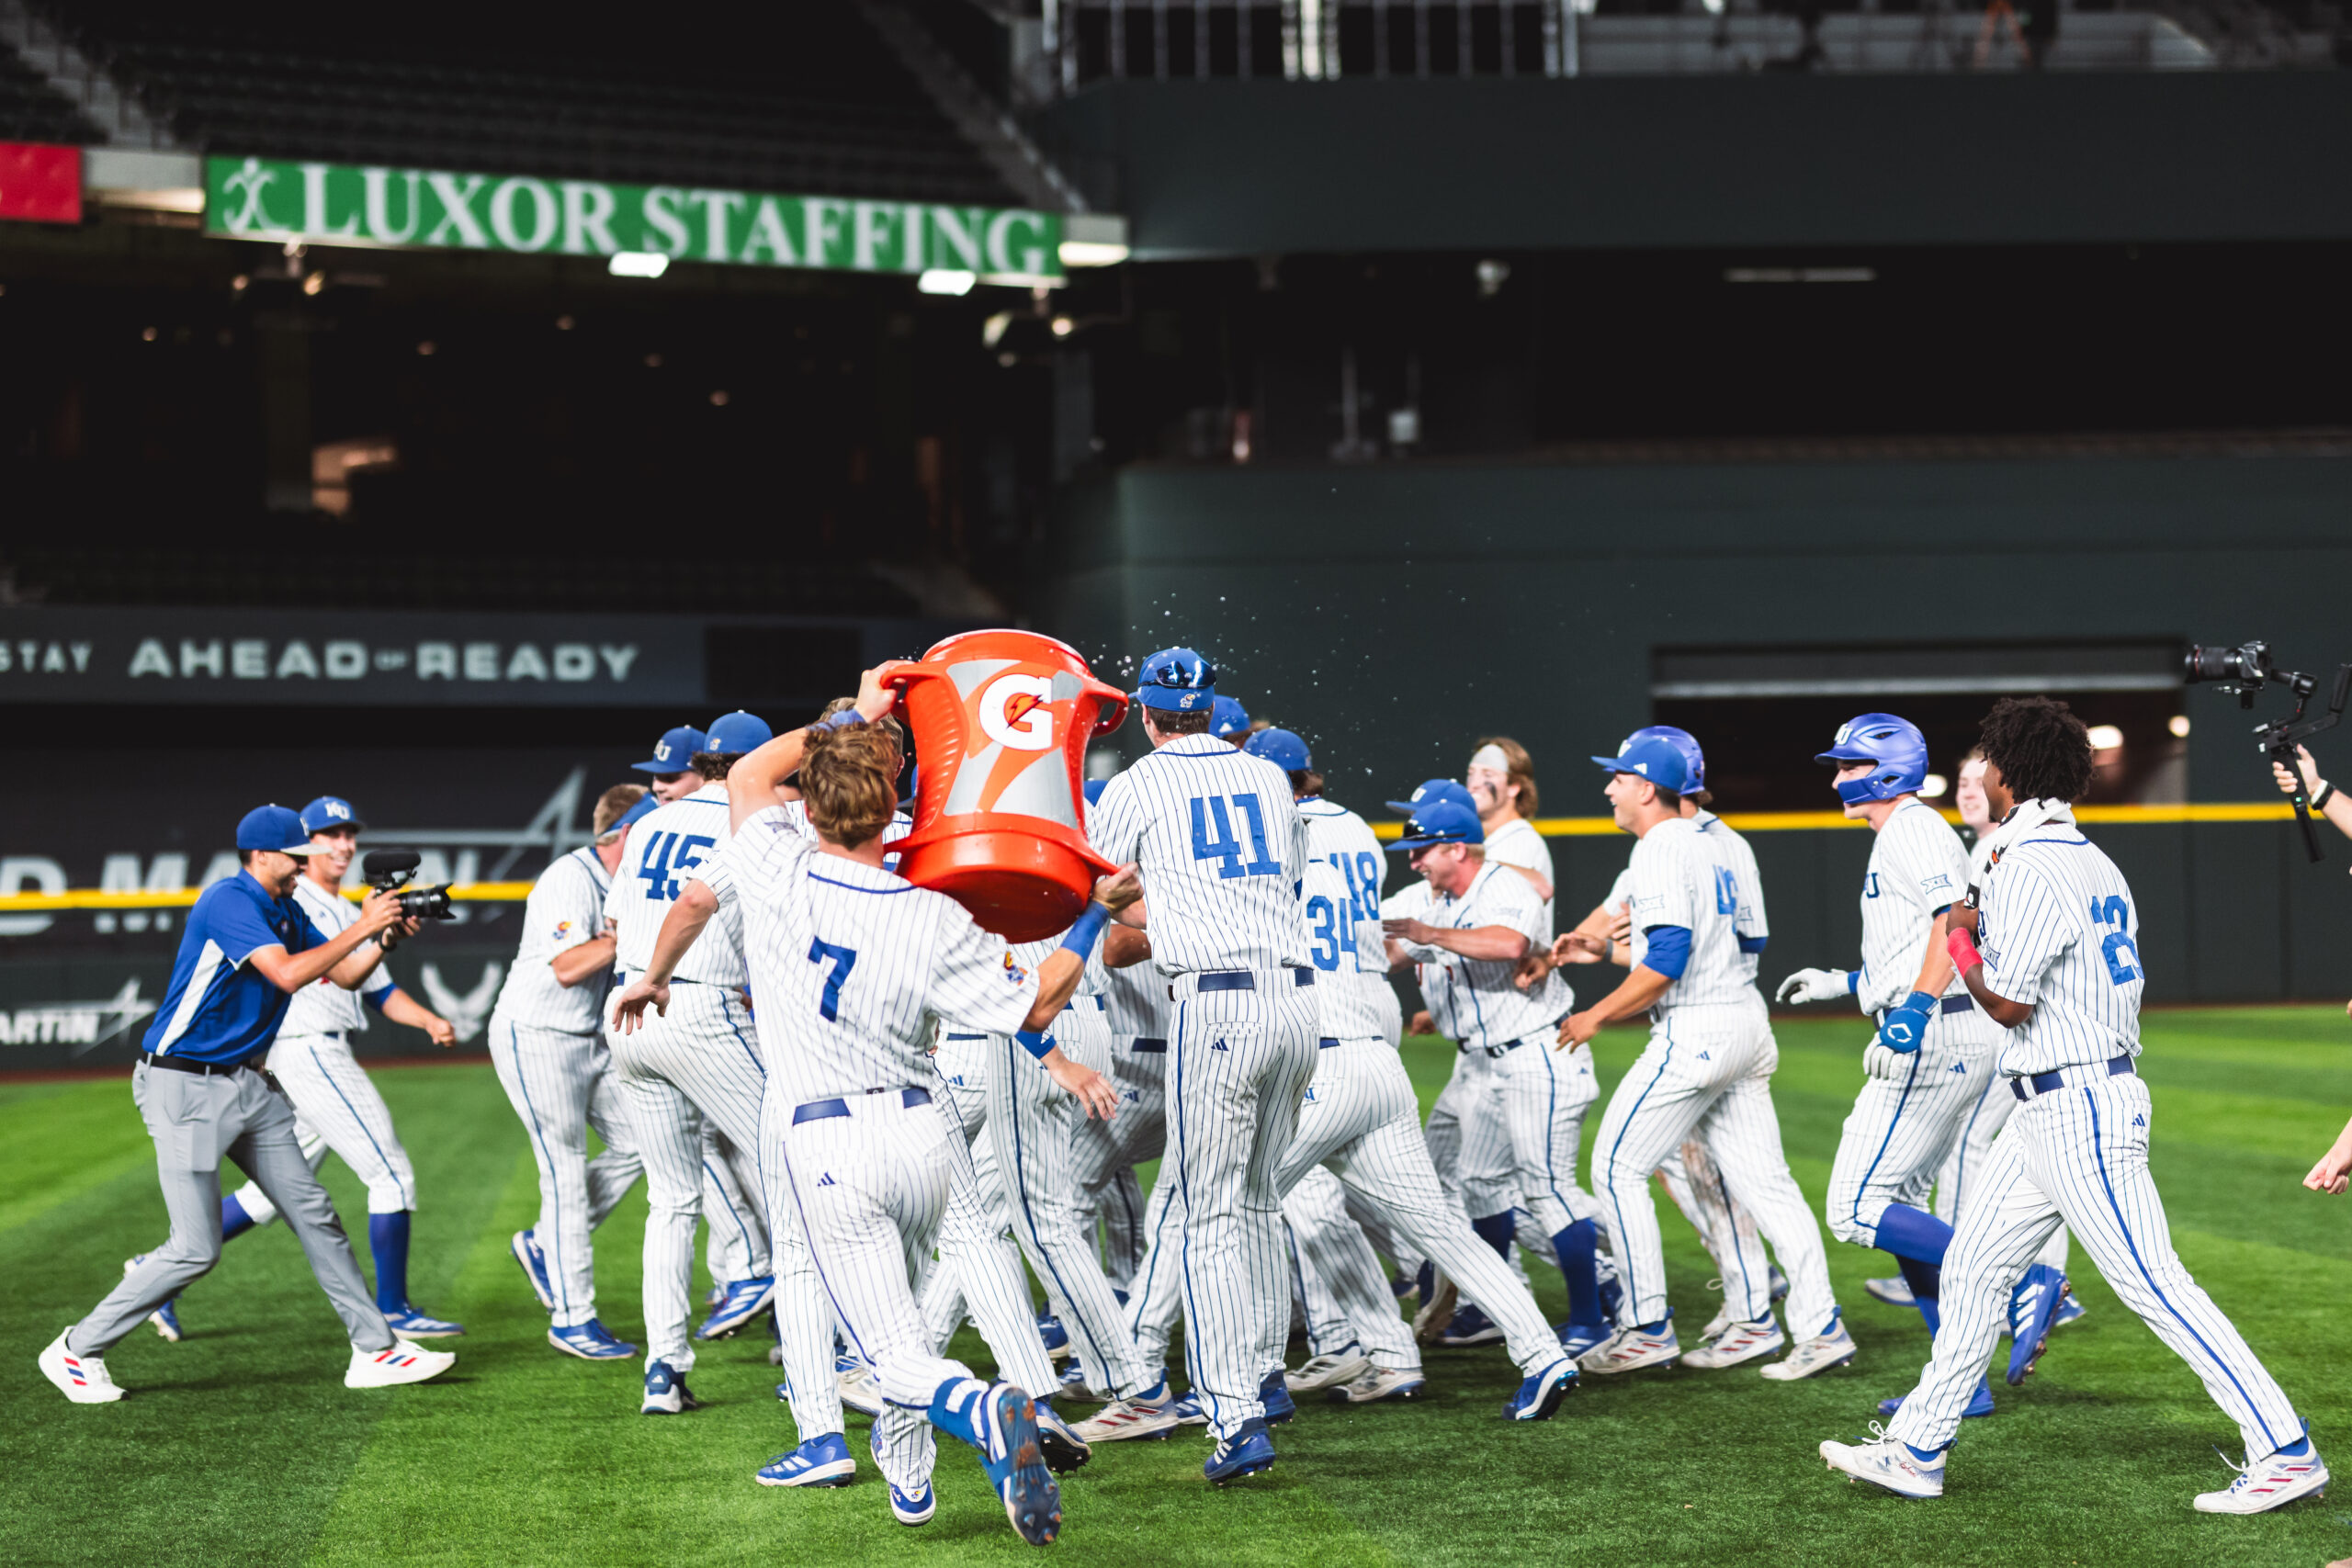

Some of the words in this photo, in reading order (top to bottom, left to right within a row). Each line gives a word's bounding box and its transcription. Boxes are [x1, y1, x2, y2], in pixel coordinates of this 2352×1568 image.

[300, 163, 621, 254] LUXOR
[642, 186, 1045, 276] STAFFING
[128, 639, 367, 679] AHEAD
[416, 644, 639, 681] READY
[637, 830, 717, 901] 45
[1190, 793, 1282, 879] 41
[1306, 896, 1361, 974] 34
[808, 936, 856, 1022] 7
